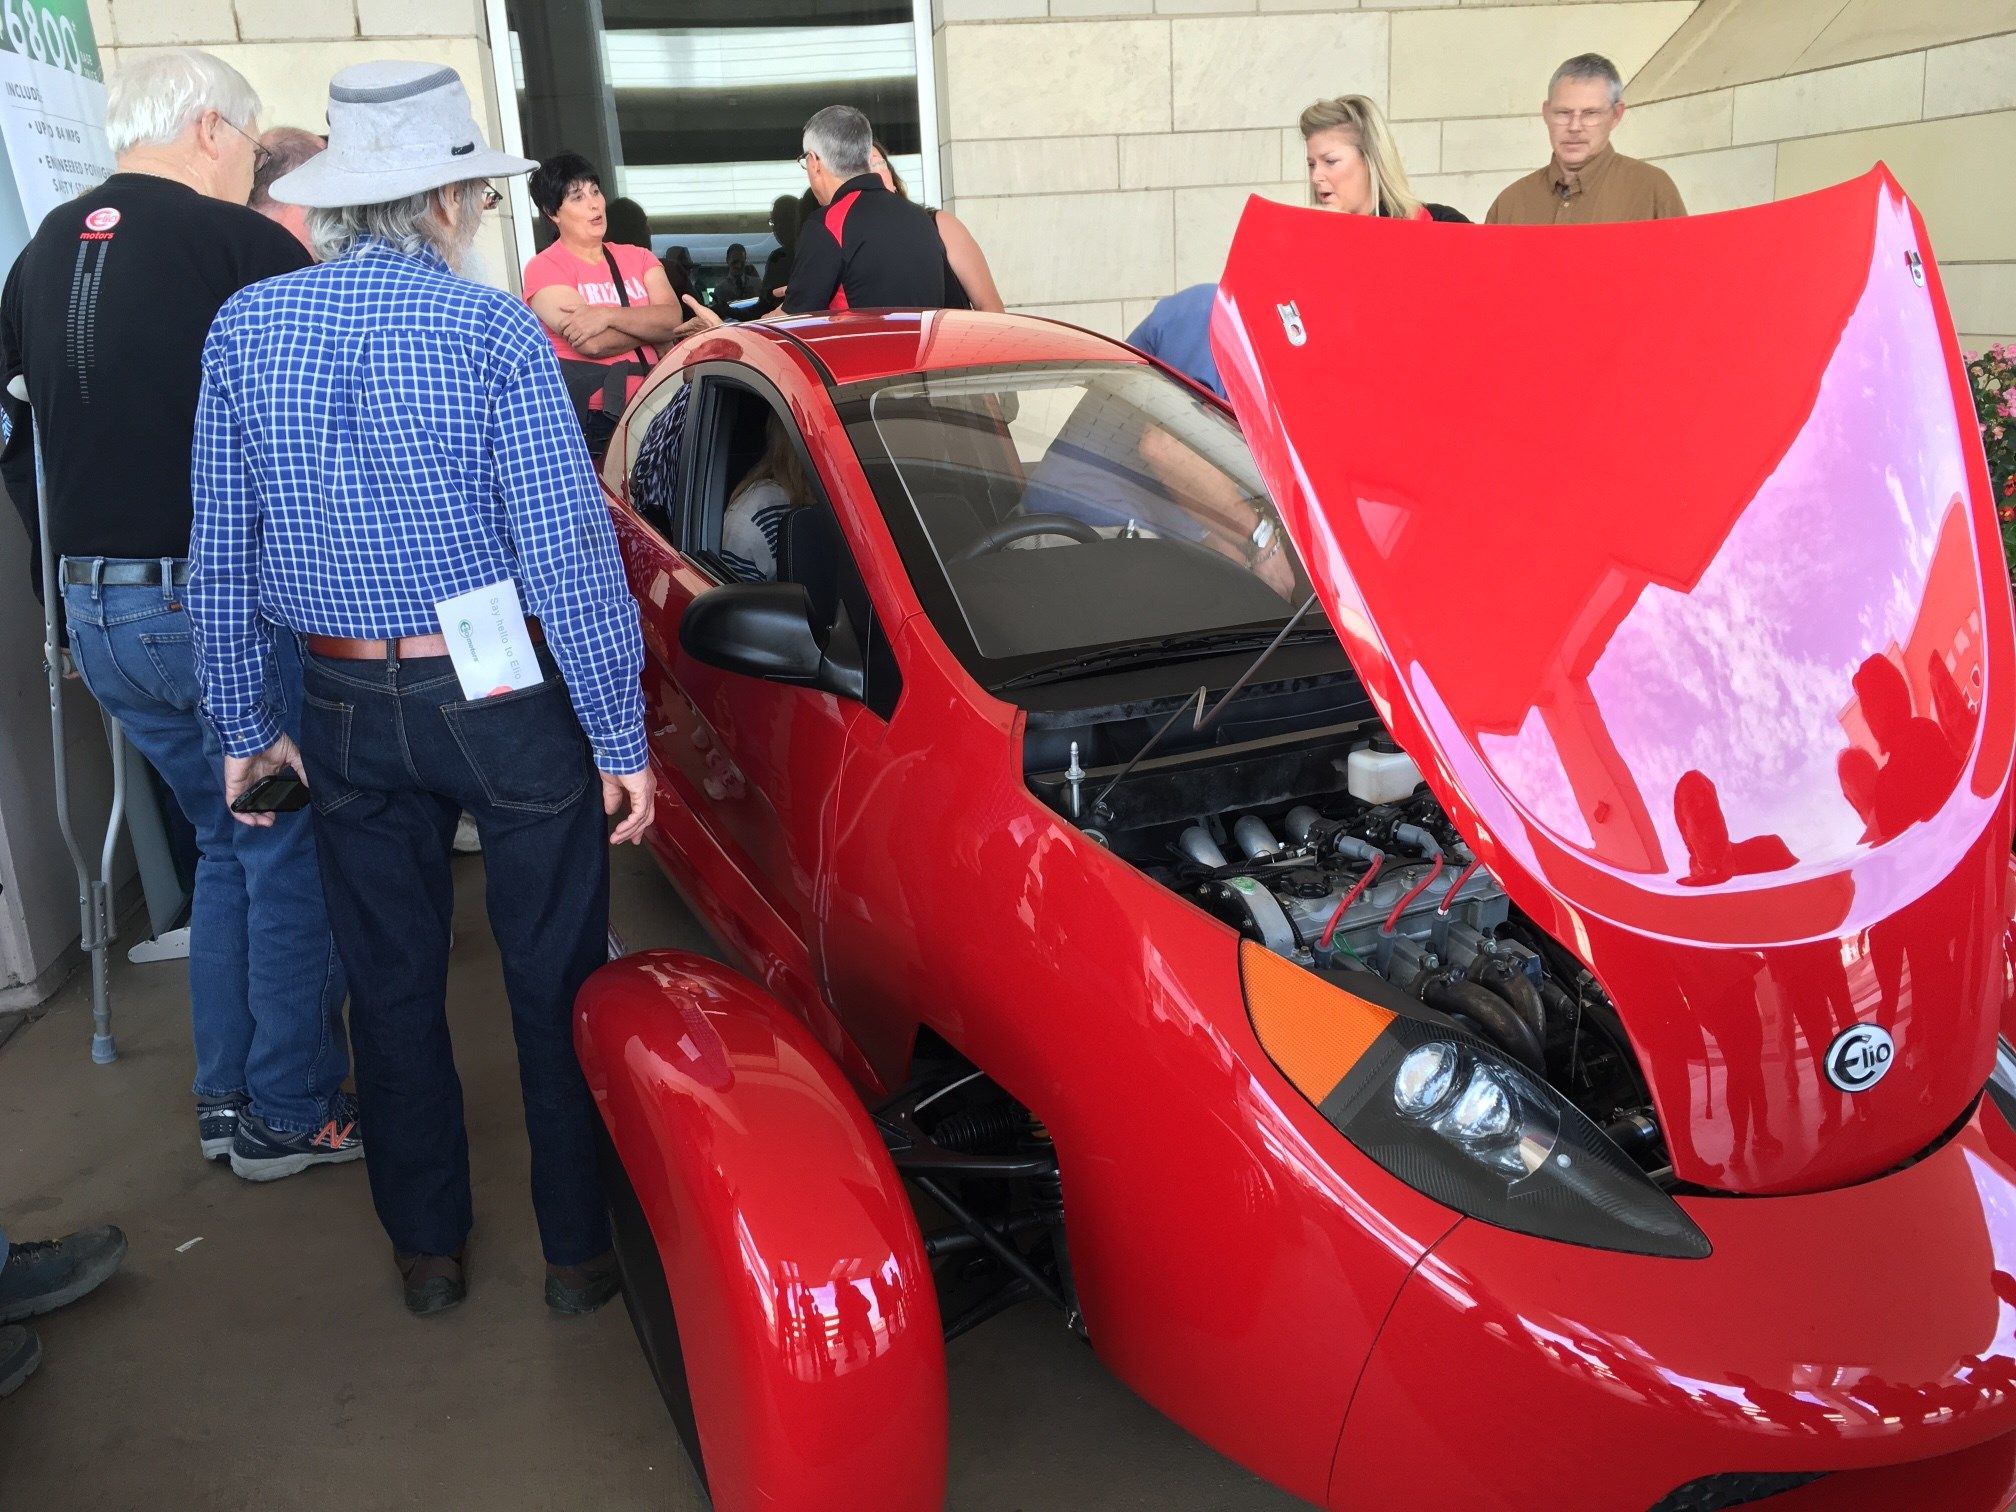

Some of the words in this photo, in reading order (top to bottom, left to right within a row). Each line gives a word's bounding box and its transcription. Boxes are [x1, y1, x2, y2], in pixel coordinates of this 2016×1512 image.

[0, 0, 82, 76] 6800
[80, 232, 114, 240] motors
[577, 276, 648, 305] ARIZNA
[467, 638, 478, 662] motors
[490, 597, 501, 615] Say
[496, 619, 509, 644] hello
[505, 647, 513, 657] to
[510, 660, 521, 680] Elio
[1832, 1034, 1891, 1085] Elio
